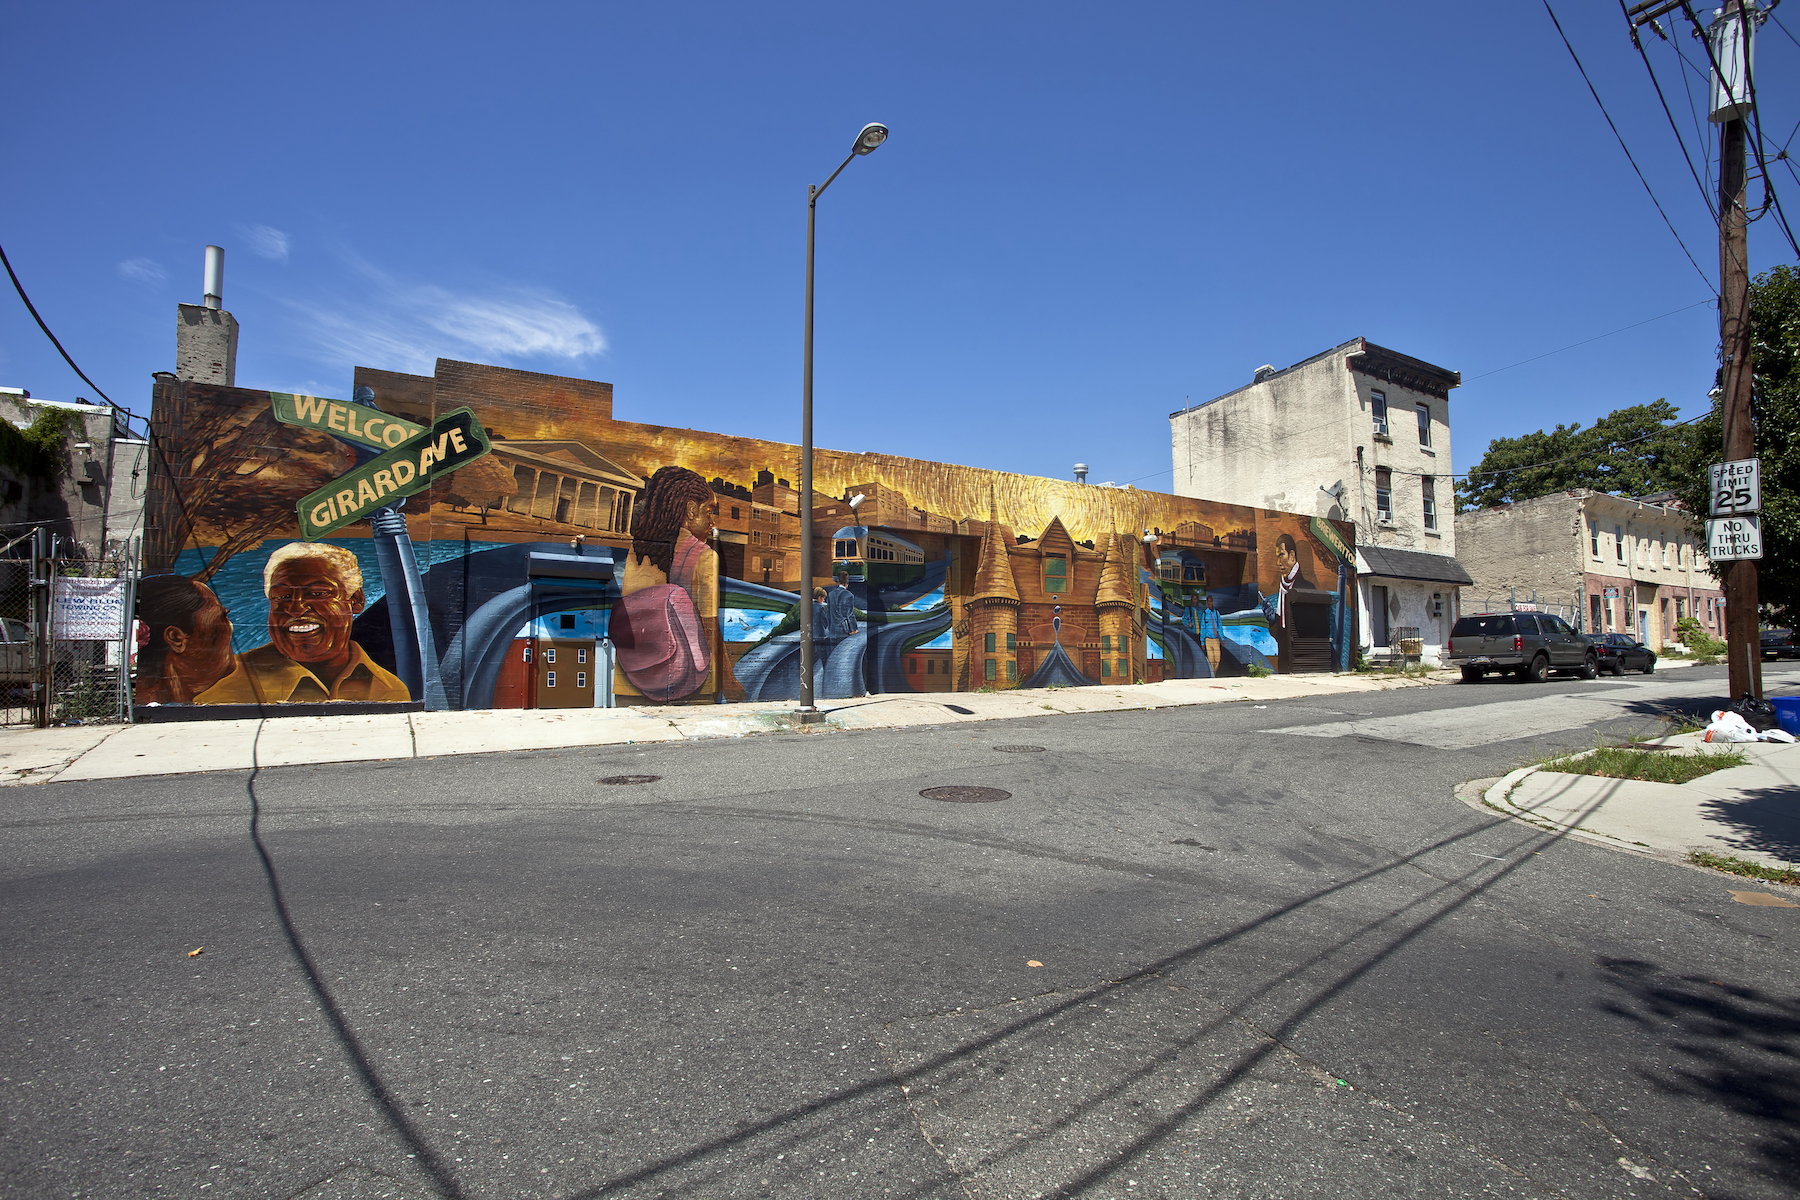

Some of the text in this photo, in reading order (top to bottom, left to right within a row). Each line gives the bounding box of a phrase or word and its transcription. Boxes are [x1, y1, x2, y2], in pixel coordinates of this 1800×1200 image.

[310, 427, 468, 527] GIRARD AVE
[1713, 465, 1753, 478] SPEED
[1717, 477, 1749, 488] LIMIT
[1717, 487, 1752, 508] 25
[1723, 521, 1742, 532] NO
[1718, 533, 1750, 544] THRU
[1711, 544, 1758, 556] TRUCKS
